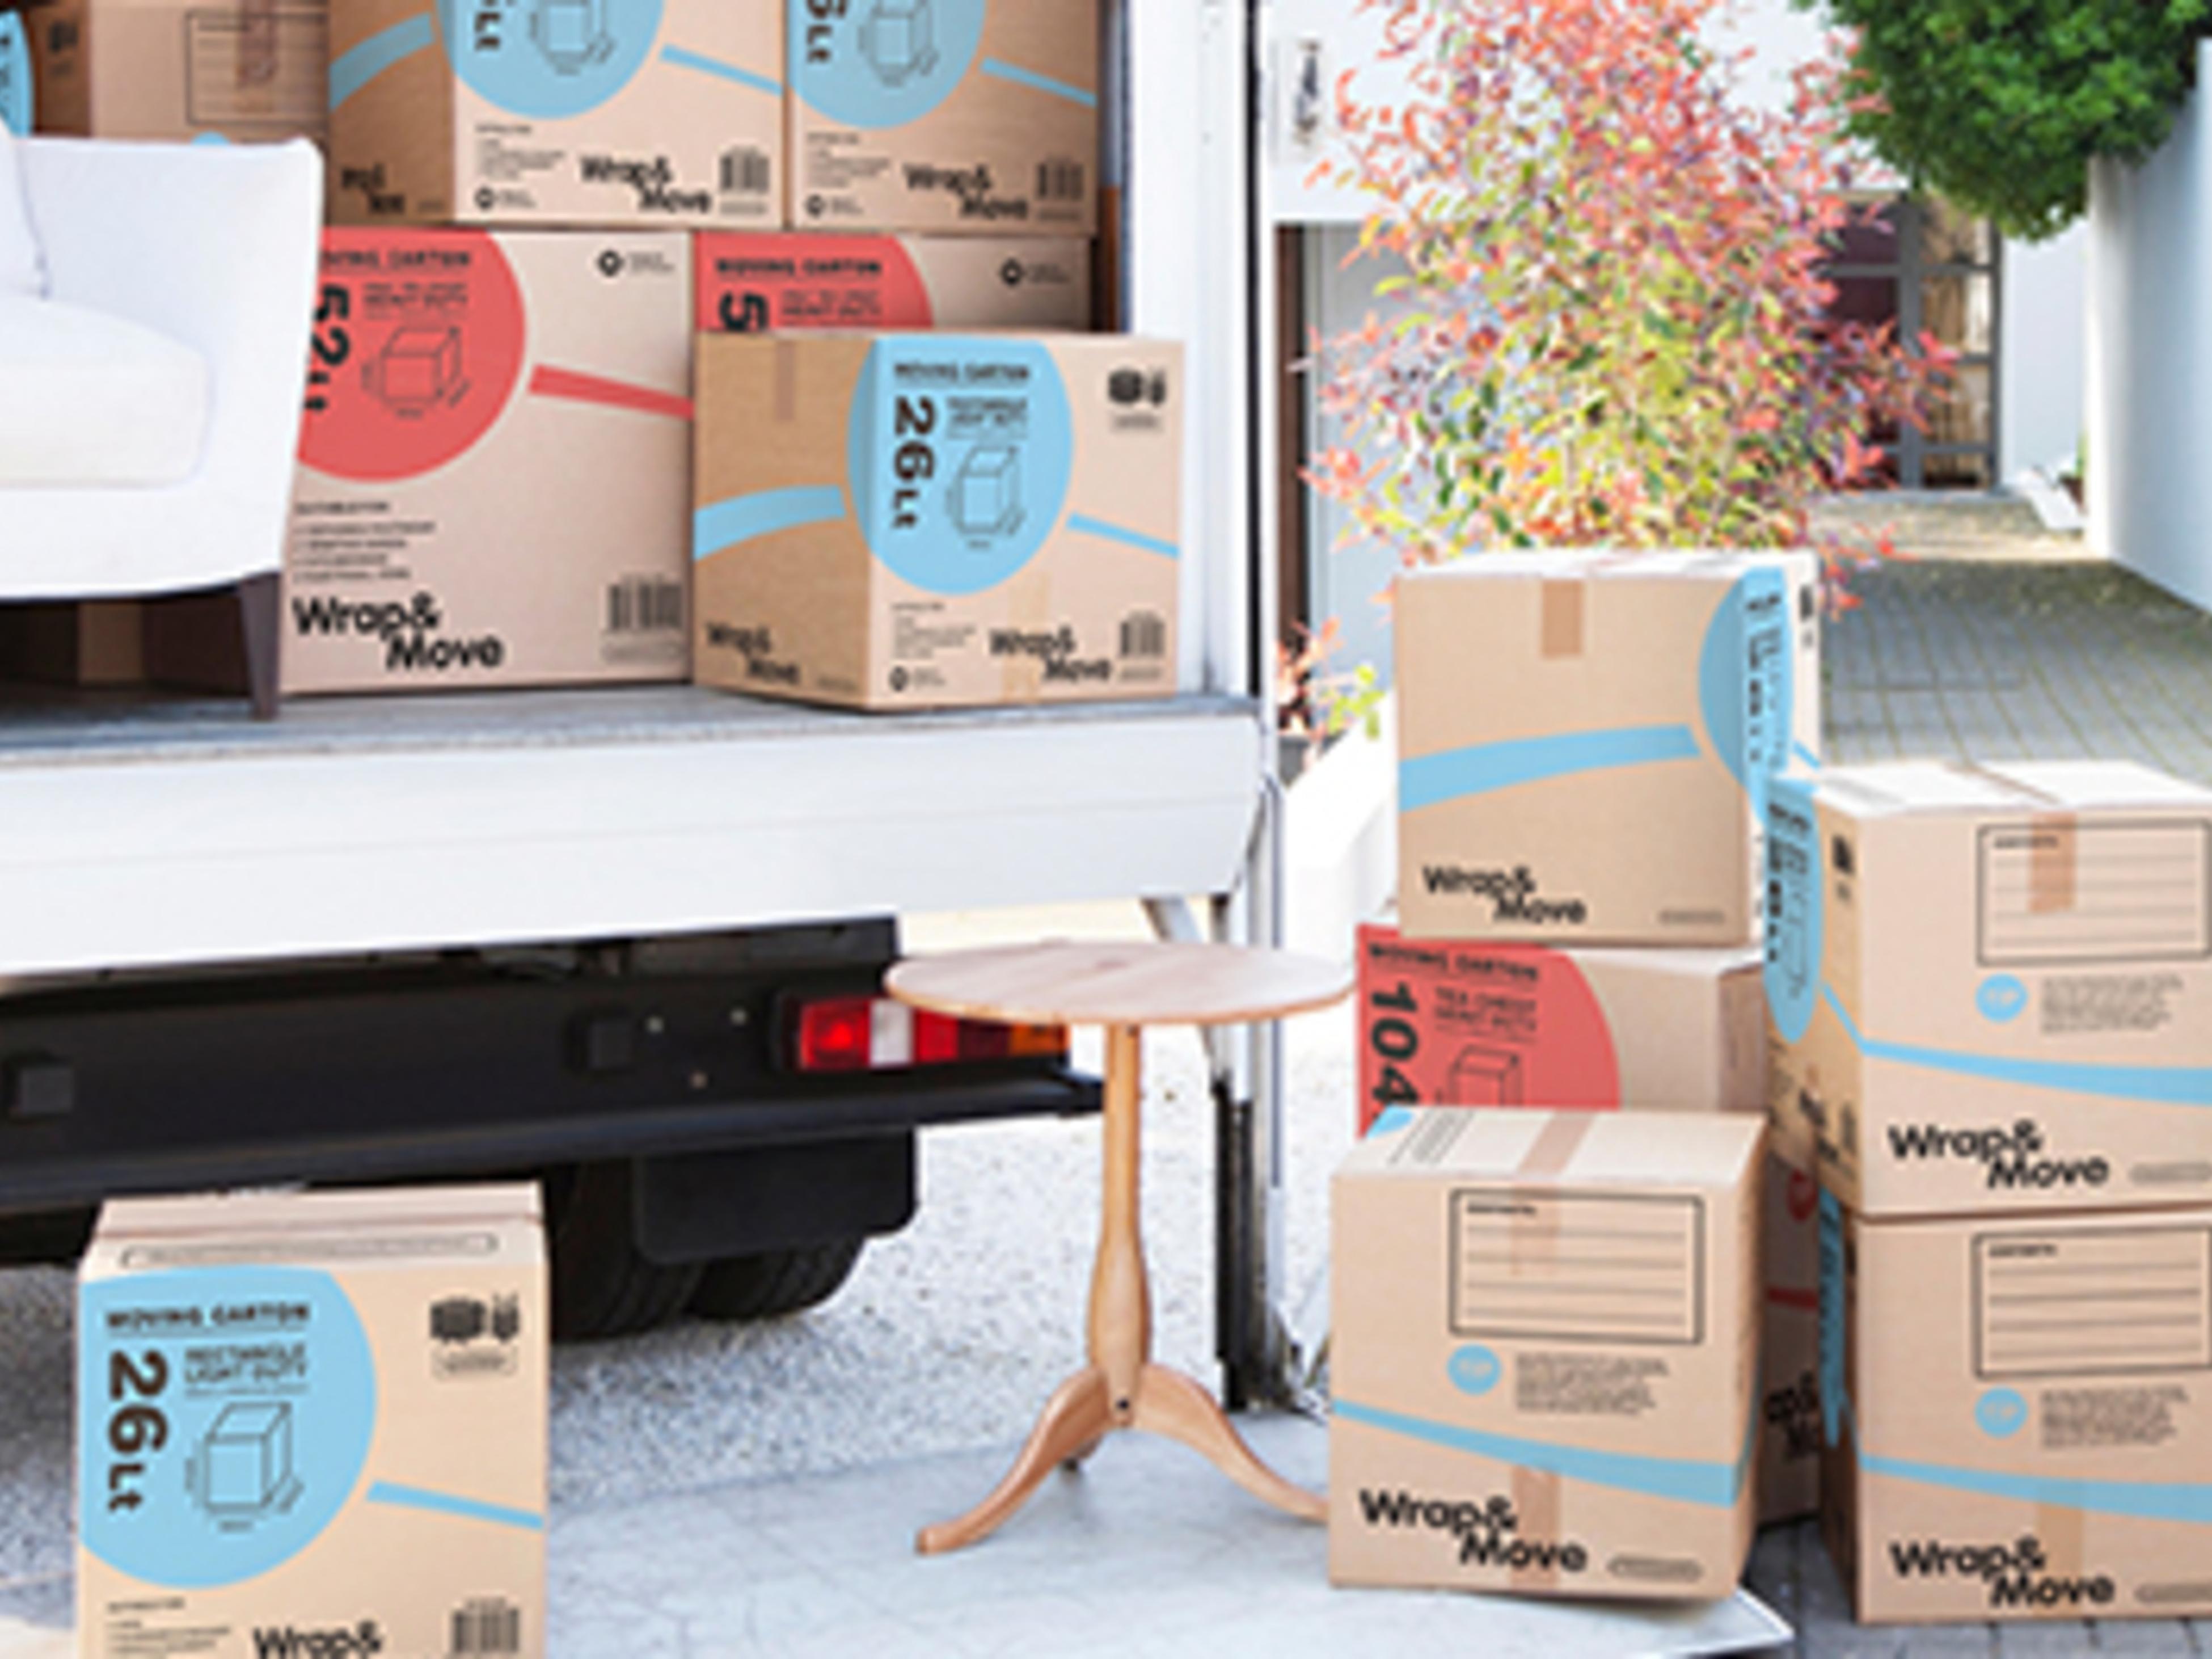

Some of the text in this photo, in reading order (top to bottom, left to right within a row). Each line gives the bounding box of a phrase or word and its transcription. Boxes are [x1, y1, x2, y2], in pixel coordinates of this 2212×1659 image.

[290, 590, 442, 641] Wrap&
[385, 633, 506, 671] Move
[1041, 656, 1112, 684] Move
[1421, 864, 1537, 903] Wrap&
[1492, 895, 1588, 925] Move
[1886, 1118, 2045, 1163] Wrap&
[1986, 1155, 2110, 1191] Move
[108, 1349, 168, 1513] 26Lt
[1358, 1487, 1519, 1537] Wrap&
[1458, 1530, 1589, 1572] Move
[1889, 1535, 2048, 1583] Wrap&
[1989, 1573, 2117, 1610] Move
[252, 1619, 384, 1659] Wrap&
